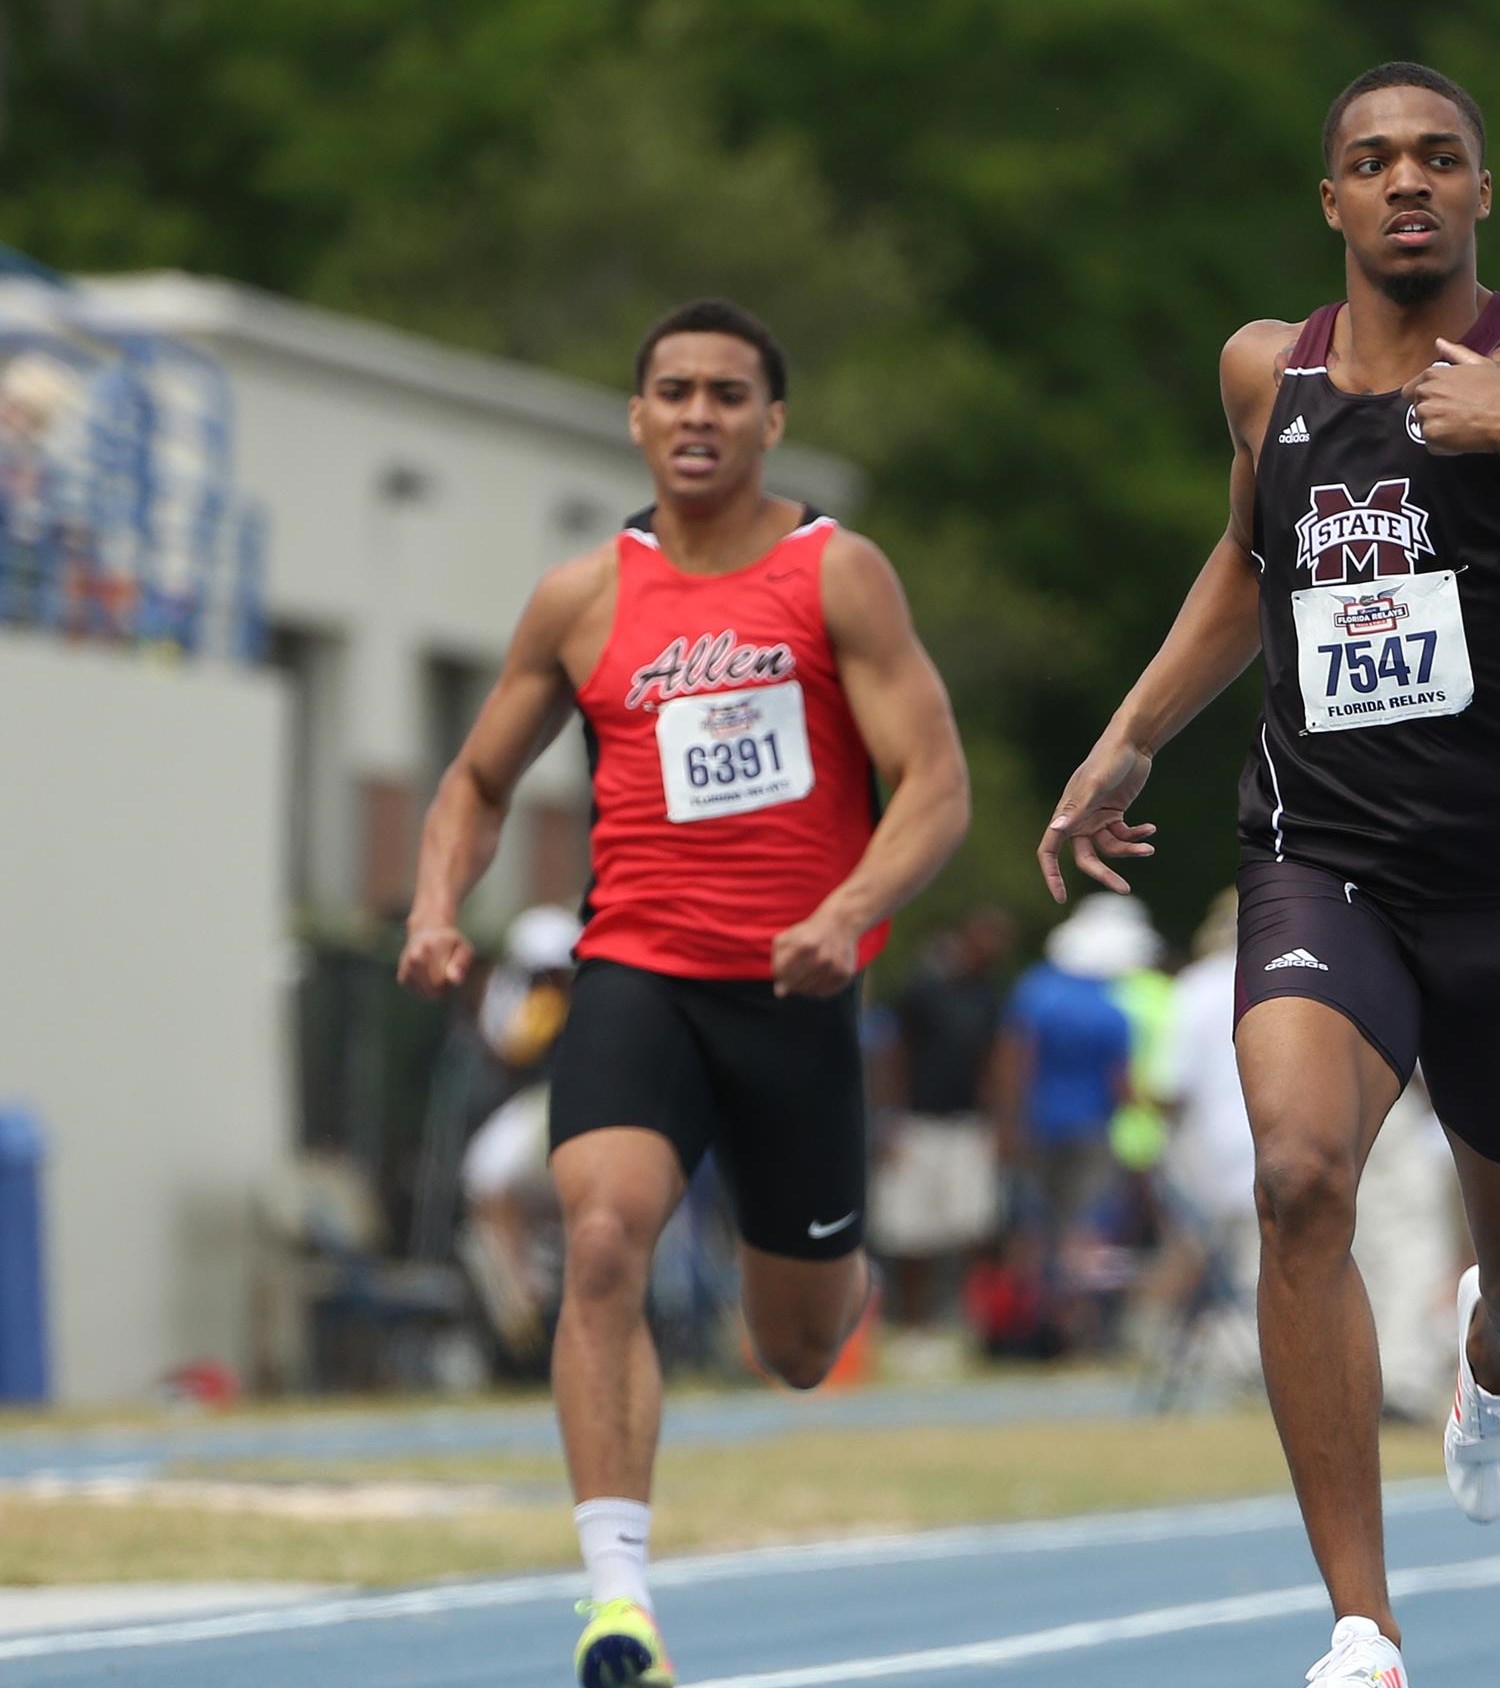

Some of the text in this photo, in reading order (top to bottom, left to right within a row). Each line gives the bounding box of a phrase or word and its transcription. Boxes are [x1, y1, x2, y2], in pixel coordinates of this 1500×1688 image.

[1279, 432, 1310, 444] adidas
[1318, 513, 1402, 546] STATE
[1337, 614, 1371, 624] FLORIDA
[1371, 608, 1404, 620] RELAYS
[624, 628, 797, 710] Allen
[1318, 630, 1438, 697] 7547
[1328, 690, 1446, 717] FLORIDA RELAYS
[687, 731, 781, 788] 6391
[1264, 960, 1328, 971] adidas
